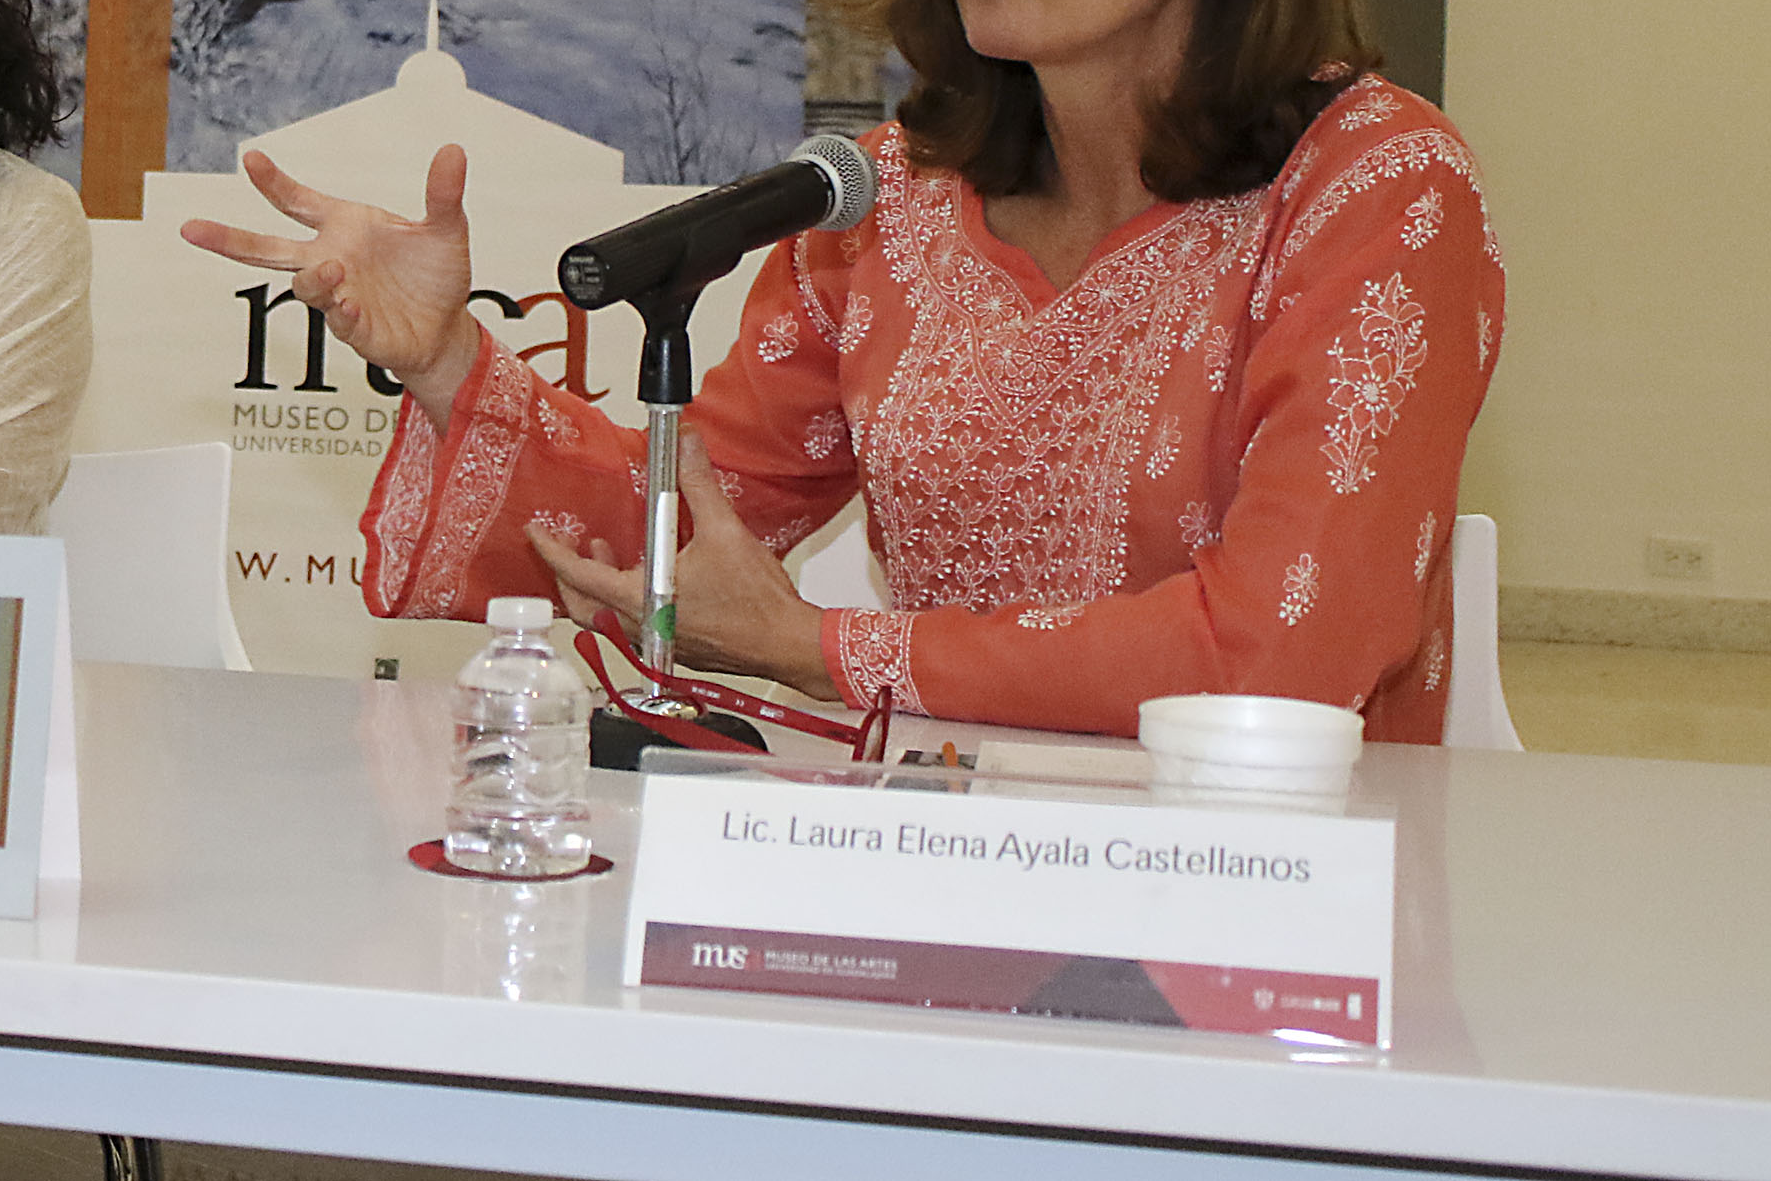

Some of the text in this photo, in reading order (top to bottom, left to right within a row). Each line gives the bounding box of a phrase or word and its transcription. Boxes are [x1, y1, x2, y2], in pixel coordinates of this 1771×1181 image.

[234, 404, 349, 431] MUSEO
[232, 435, 382, 457] UNIVERSIDAD
[722, 811, 1311, 883] Lic. Laura Elena Ayala Castellanos
